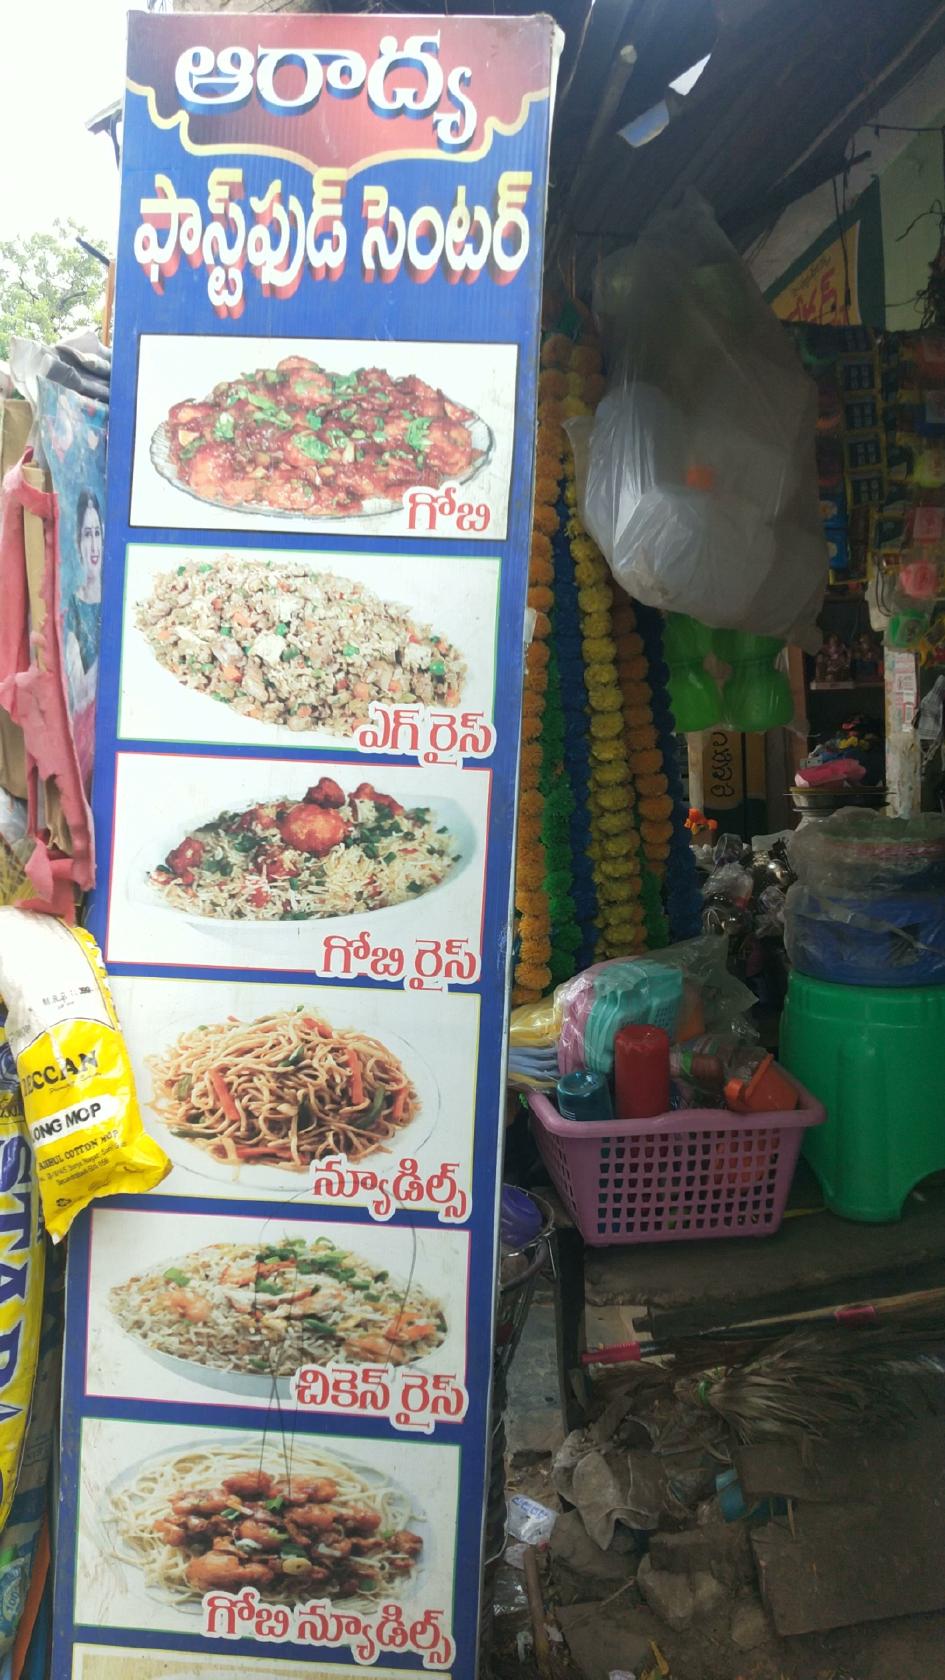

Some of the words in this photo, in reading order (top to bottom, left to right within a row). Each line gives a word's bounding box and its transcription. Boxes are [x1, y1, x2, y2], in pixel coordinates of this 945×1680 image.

[362, 171, 532, 274] సెంటర్
[407, 487, 491, 532] గోబి
[423, 712, 492, 766] రైస్
[322, 931, 405, 977] గోబి
[408, 937, 477, 992] రైస్
[295, 1367, 390, 1409] చికెన్
[395, 1373, 464, 1428] రైస్
[207, 1592, 289, 1638] గోబి
